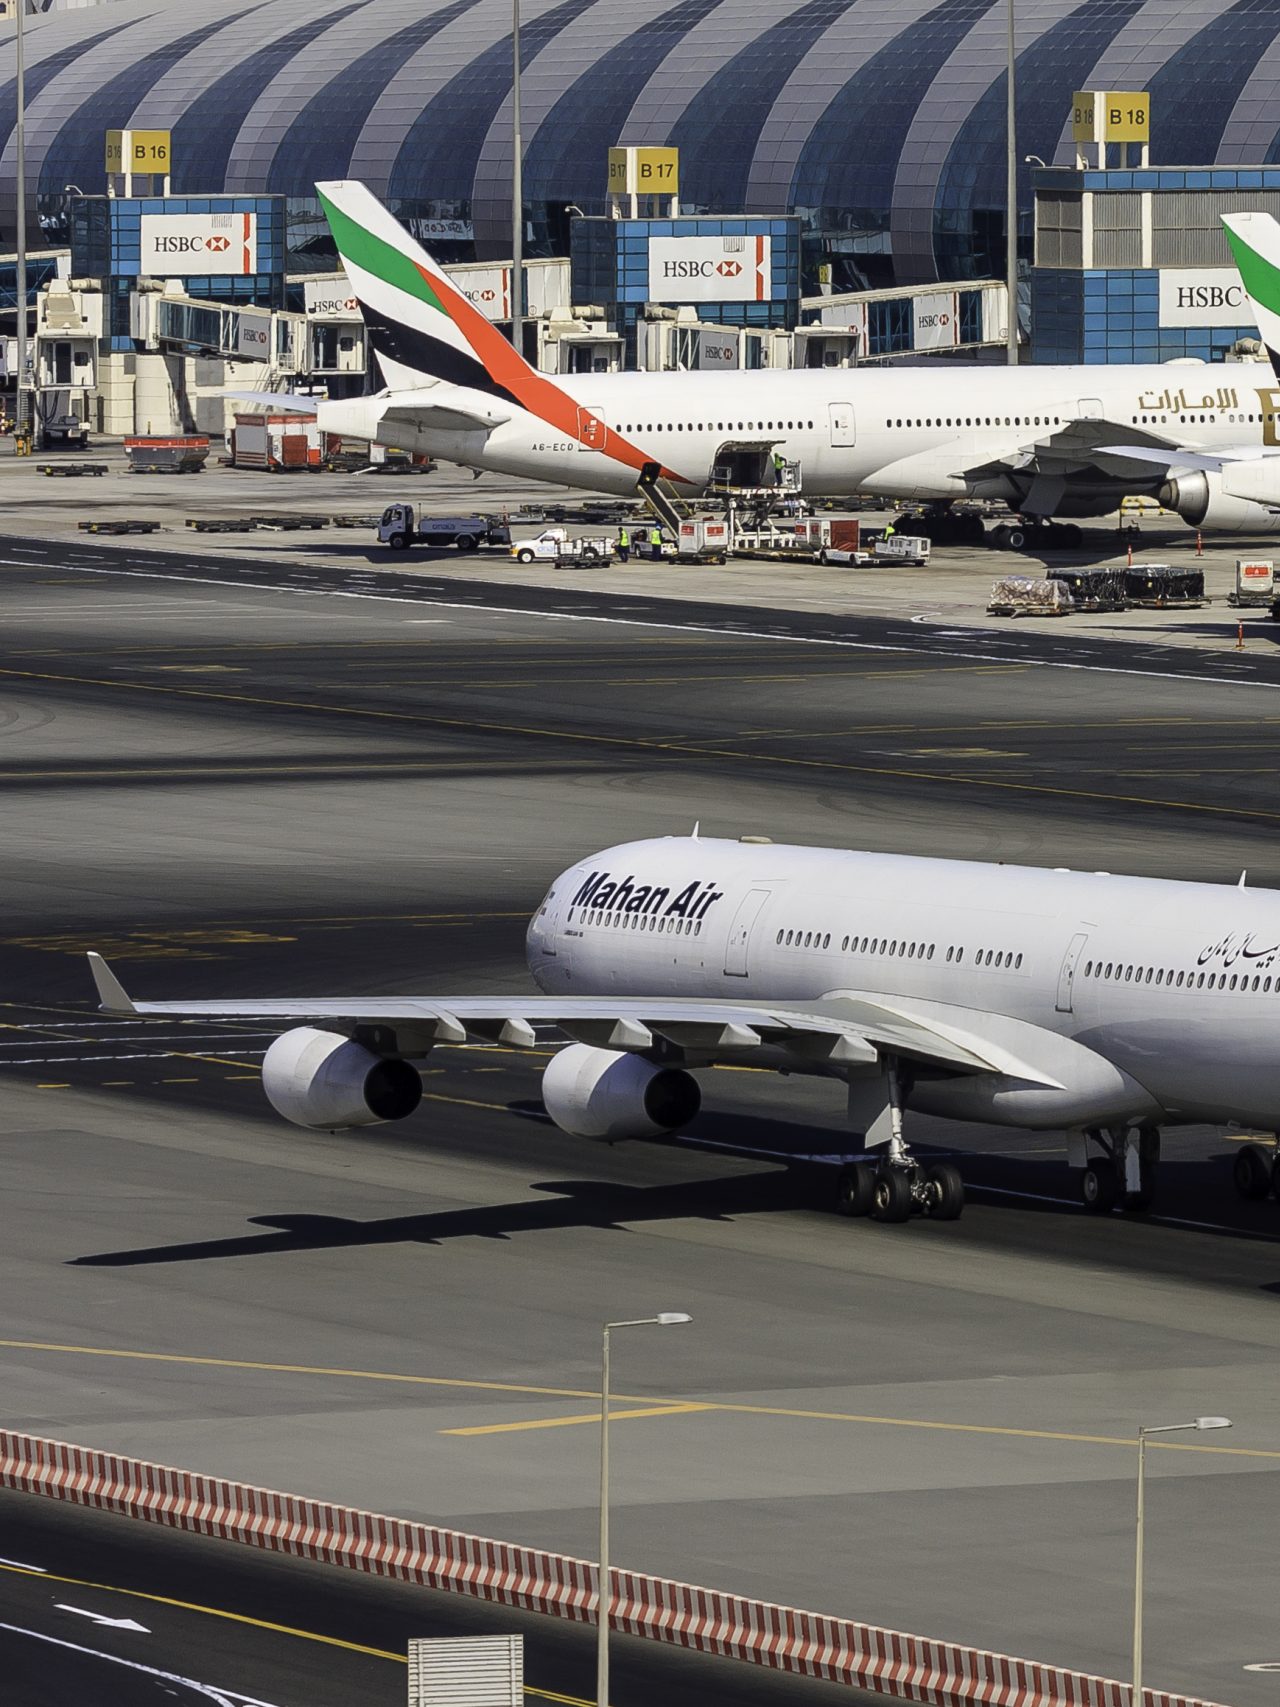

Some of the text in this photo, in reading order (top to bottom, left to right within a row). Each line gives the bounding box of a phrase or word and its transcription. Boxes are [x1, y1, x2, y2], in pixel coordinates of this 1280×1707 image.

[1075, 109, 1094, 125] B 18
[1110, 109, 1145, 125] B 18
[107, 144, 113, 158] B
[135, 145, 167, 159] B 16
[610, 163, 626, 177] B 17
[641, 163, 674, 178] B 17
[154, 236, 203, 252] HSBC
[663, 261, 714, 277] HSBC
[1176, 286, 1242, 308] HSBC
[918, 314, 939, 329] HSBC
[705, 346, 724, 359] HSBC
[1138, 388, 1239, 413] الإمارات
[532, 443, 574, 451] A6-ECO
[571, 871, 724, 920] Mahan Air
